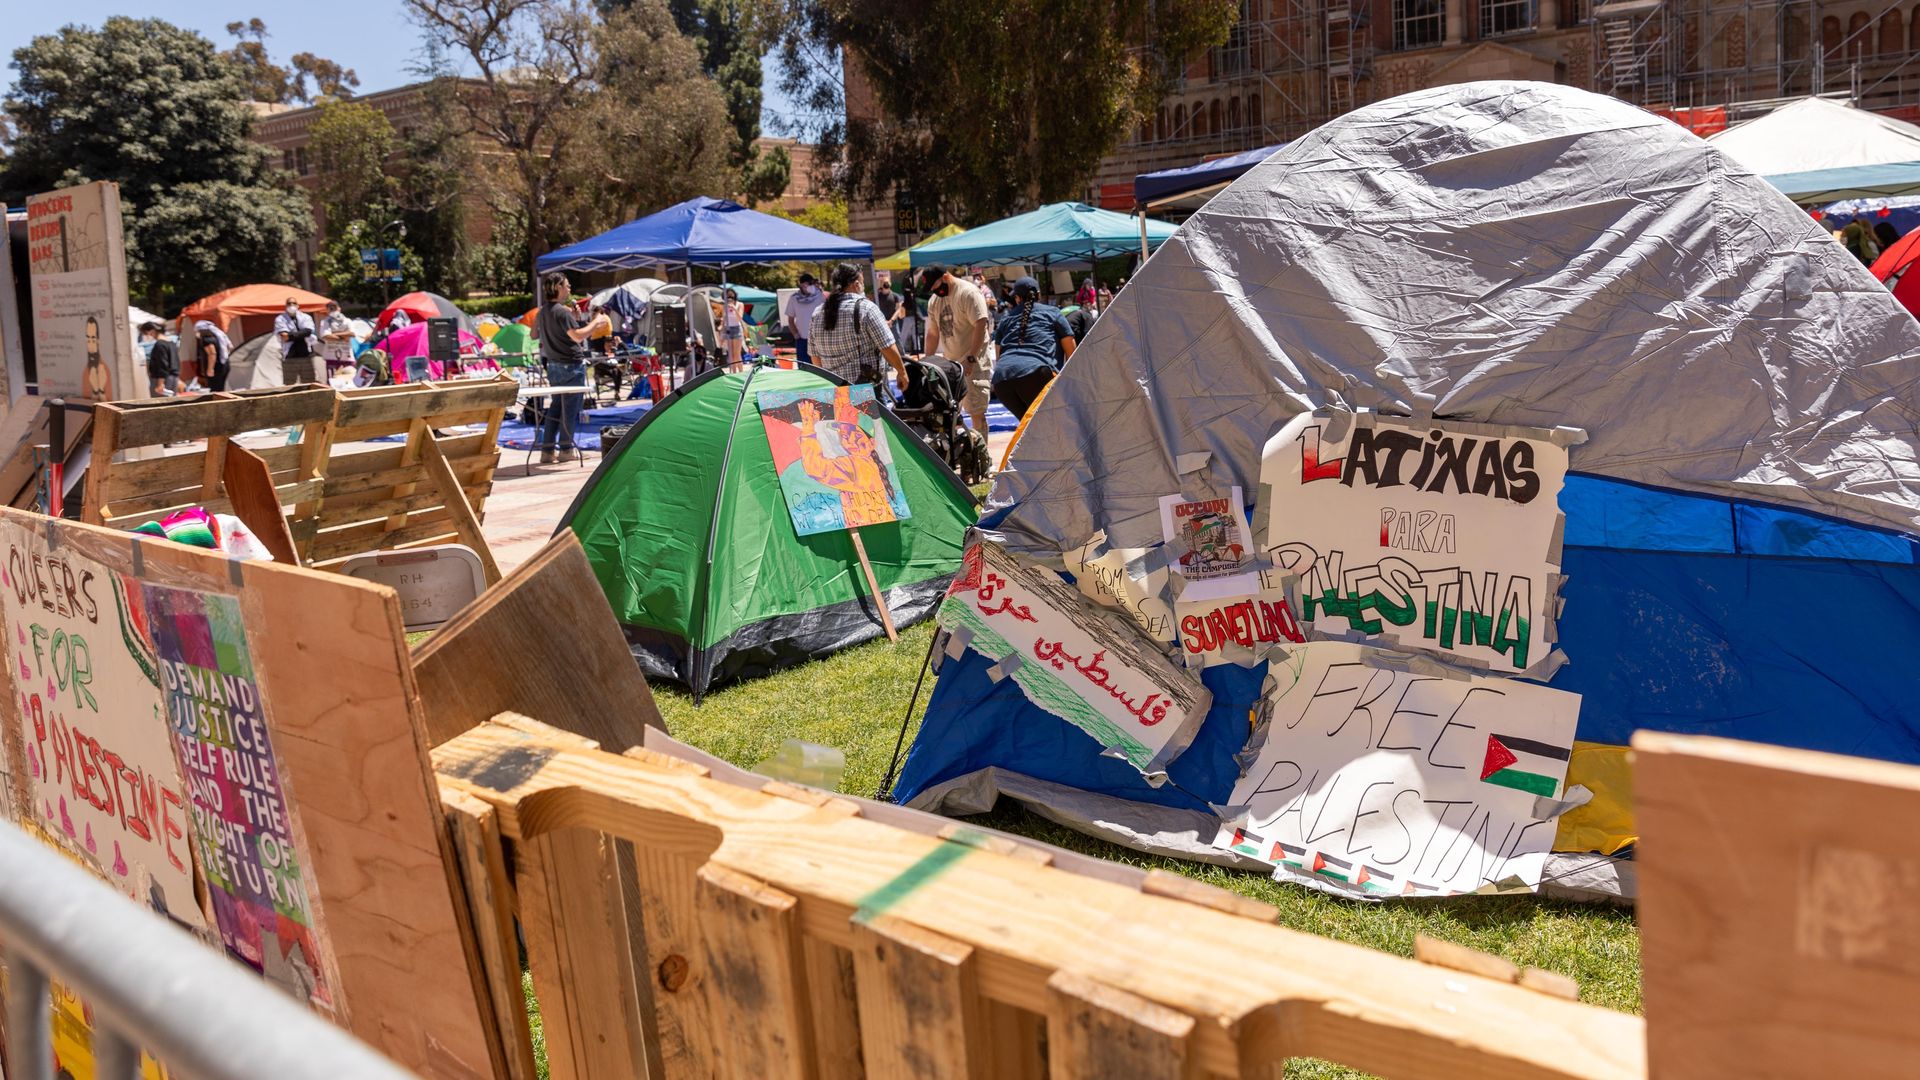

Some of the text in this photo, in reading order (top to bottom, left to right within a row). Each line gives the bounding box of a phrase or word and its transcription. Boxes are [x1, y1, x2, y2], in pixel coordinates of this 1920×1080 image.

[1380, 507, 1456, 554] PARA
[9, 543, 98, 624] QUEERS
[1138, 597, 1173, 637] SEA
[1268, 542, 1531, 669] PALESTINA
[29, 621, 98, 713] FOR
[977, 573, 1172, 727] فلسطين حرة
[161, 658, 255, 714] DEMAND
[1286, 662, 1506, 770] FREE
[175, 696, 266, 755] JUSTICE
[29, 694, 187, 875] PALESTINE
[178, 735, 275, 794] SELF RULE
[190, 772, 285, 835] AND THE
[194, 804, 290, 871] RIGHT OF
[203, 841, 301, 909] RETURN
